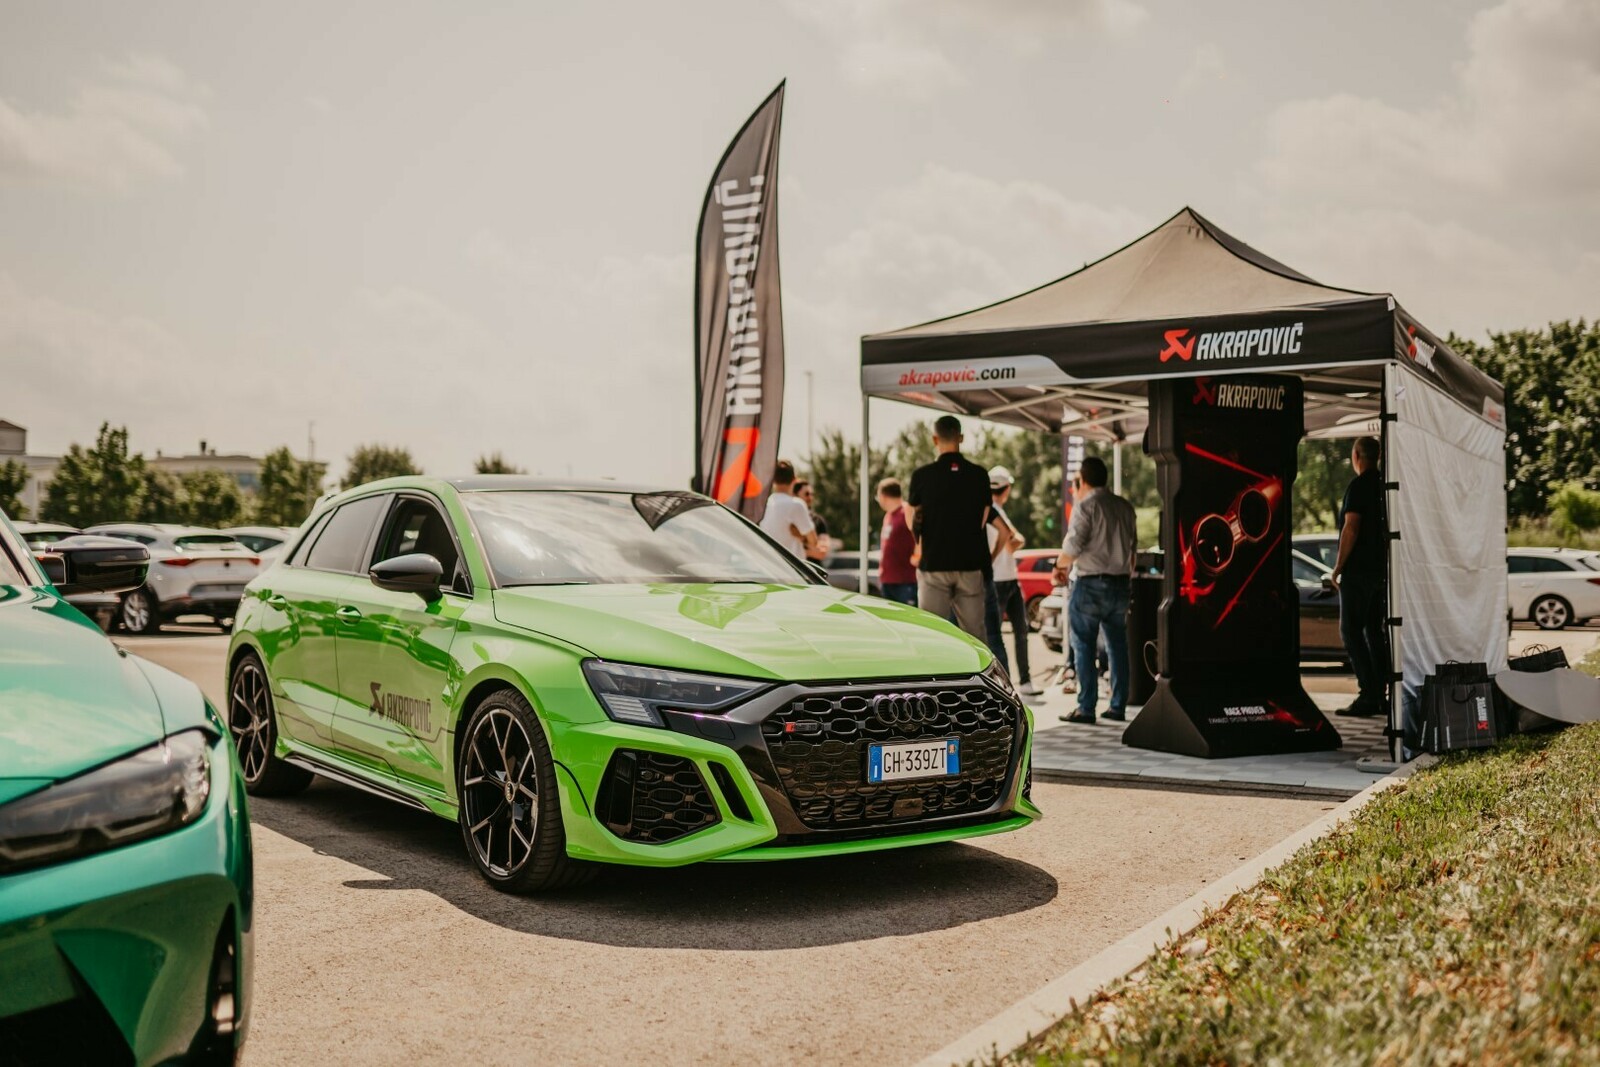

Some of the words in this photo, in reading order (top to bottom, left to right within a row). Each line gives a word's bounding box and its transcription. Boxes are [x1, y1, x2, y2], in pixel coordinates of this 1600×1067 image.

[1196, 322, 1303, 360] AKRAPOVIČ
[898, 366, 1016, 387] akrapovic.com
[1217, 384, 1286, 411] AKRAPOVIČ
[387, 692, 432, 734] AKRAPOVIČ
